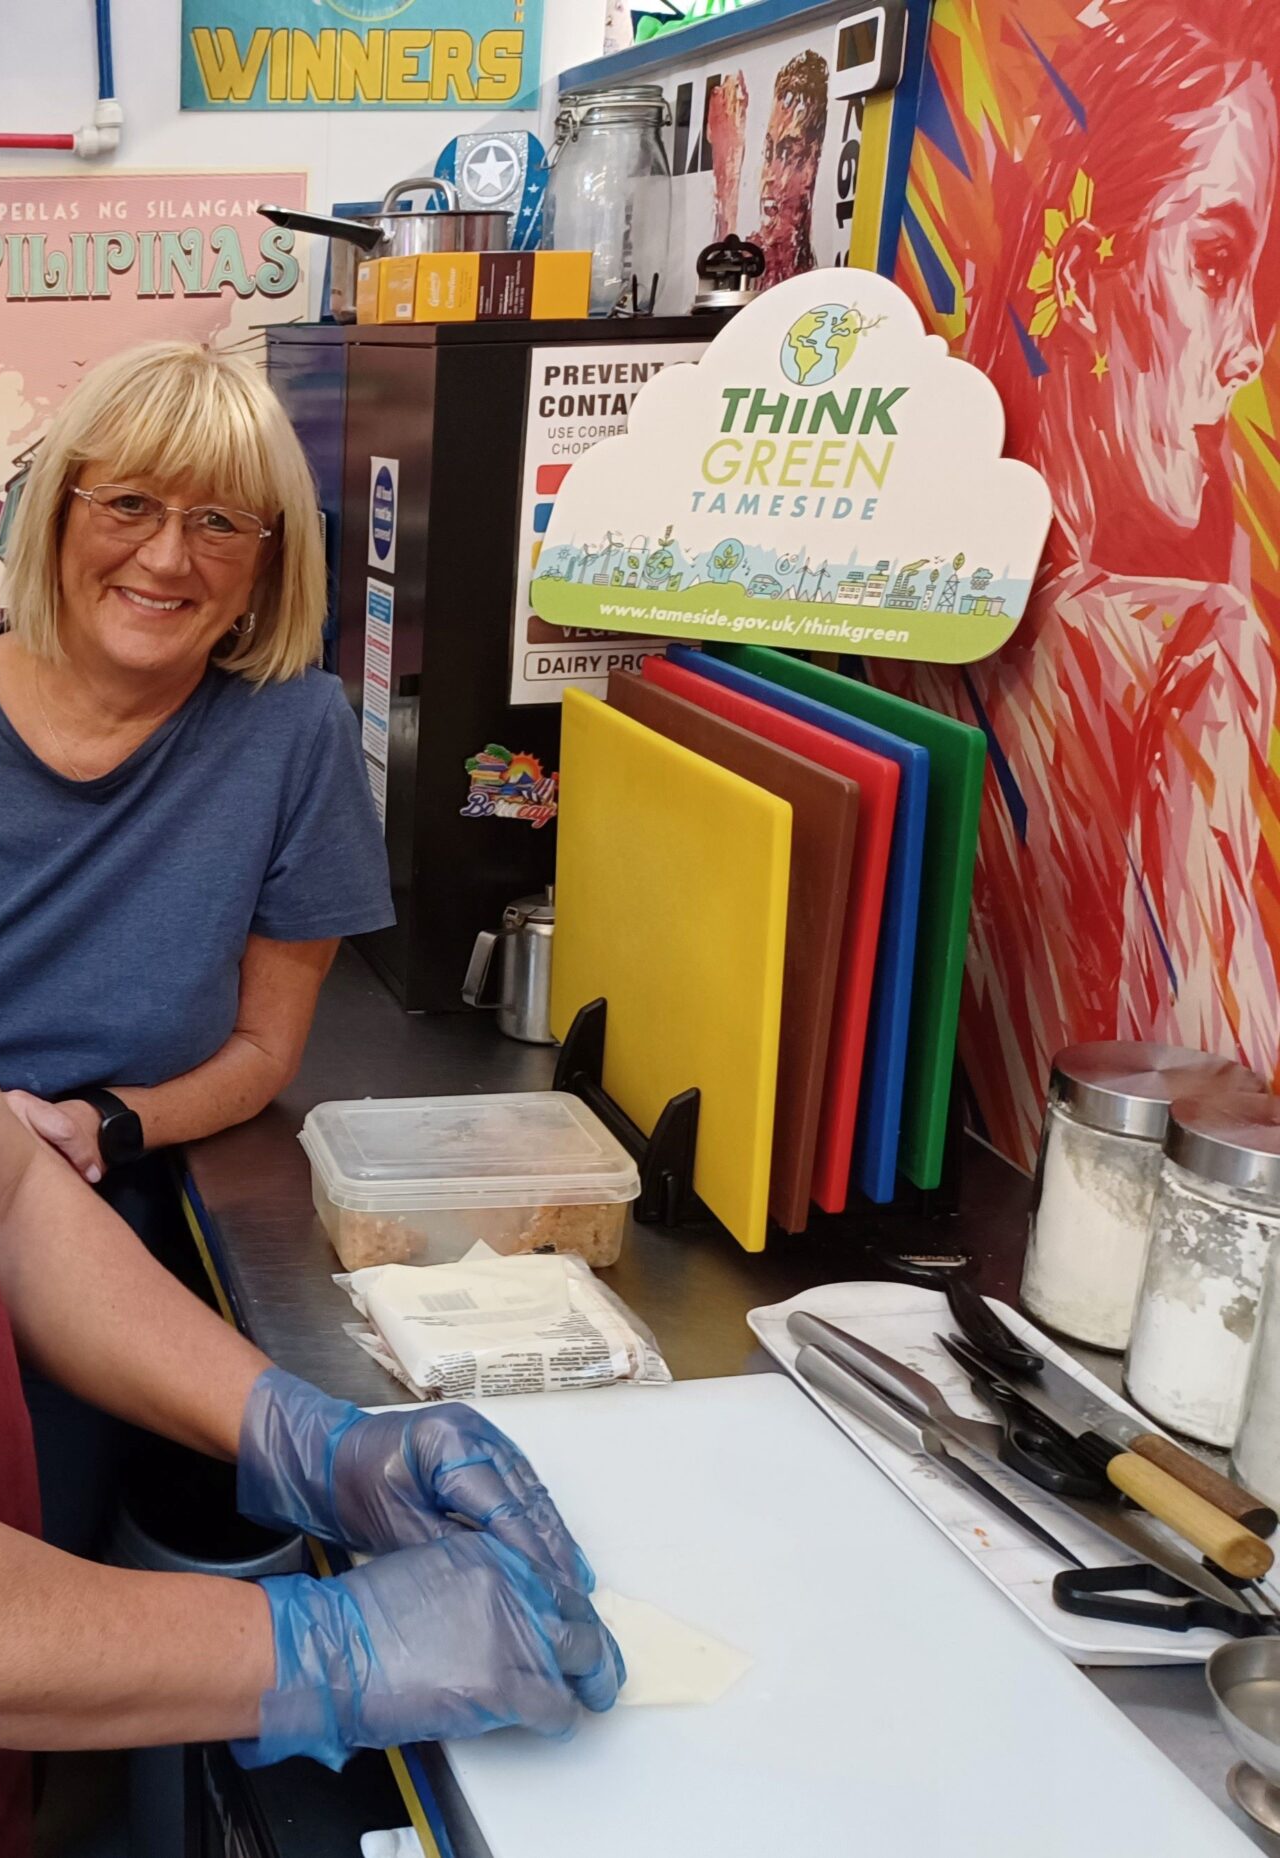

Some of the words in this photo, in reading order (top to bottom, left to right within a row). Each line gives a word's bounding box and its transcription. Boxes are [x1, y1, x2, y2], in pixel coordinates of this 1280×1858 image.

[190, 27, 525, 104] WINNERS
[99, 202, 127, 219] NG
[147, 199, 260, 219] SILANGAN
[544, 362, 664, 386] PREVENT
[720, 387, 910, 435] THINK
[548, 426, 574, 439] USE
[578, 424, 628, 438] CORRE
[552, 442, 597, 454] CHOP
[701, 438, 895, 491] GREEN
[690, 491, 878, 520] TAMESIDE
[599, 602, 910, 643] www.tameside.gov.uk/thinkgreen
[537, 656, 601, 674] DAIRY
[607, 653, 665, 671] PRO
